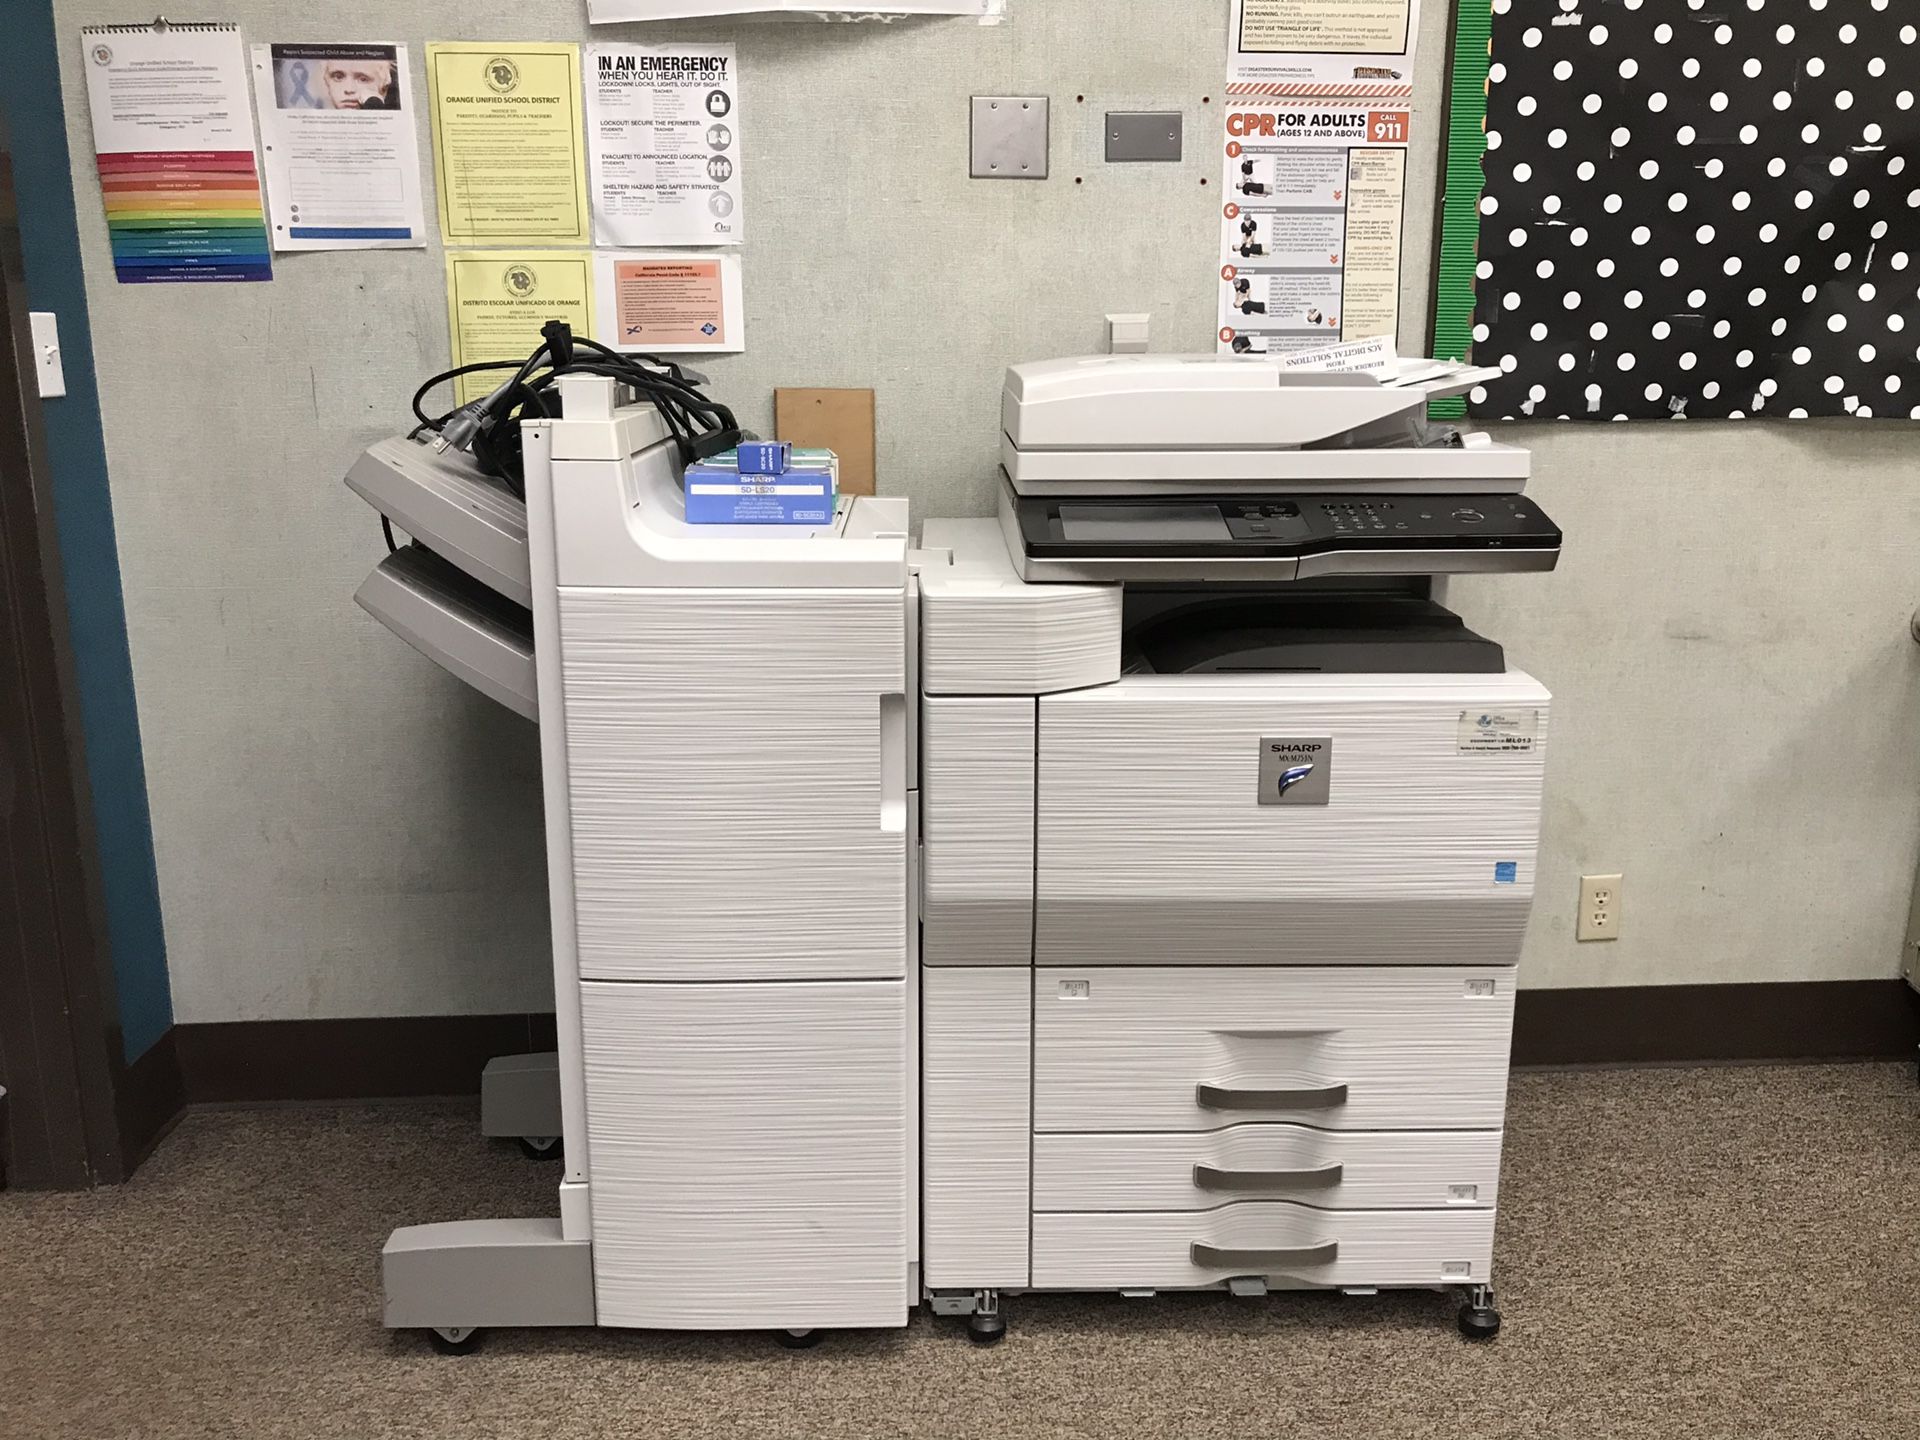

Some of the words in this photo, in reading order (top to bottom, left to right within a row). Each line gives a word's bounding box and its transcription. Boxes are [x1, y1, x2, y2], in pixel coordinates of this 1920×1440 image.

[598, 55, 612, 71] IN
[615, 55, 636, 71] AN
[640, 56, 728, 72] EMERGENCY
[598, 71, 629, 81] WHEN
[630, 71, 654, 81] YOU
[656, 71, 684, 81] HEAR
[687, 71, 698, 82] IT.
[700, 72, 715, 82] DO
[718, 72, 728, 82] IT.
[446, 96, 474, 104] ORANGE
[531, 97, 560, 105] DISTRICT
[1278, 114, 1306, 127] FOR
[1310, 114, 1366, 127] ADULTS
[1379, 114, 1397, 122] CALL
[1226, 113, 1276, 137] CPR
[1277, 129, 1301, 139] (AGES
[1303, 130, 1312, 138] 12
[1314, 130, 1332, 139] AND
[1334, 130, 1366, 140] ABOVE)
[1373, 123, 1402, 140] 911
[1239, 206, 1277, 214] Compressions
[1331, 347, 1367, 361] DIGITAL
[1366, 343, 1384, 355] ACS
[1286, 353, 1332, 367] SOLUTIONS
[1325, 359, 1346, 368] FROM
[1354, 360, 1386, 371] REORDER
[740, 476, 777, 484] SHARP
[1271, 744, 1323, 753] SHARP
